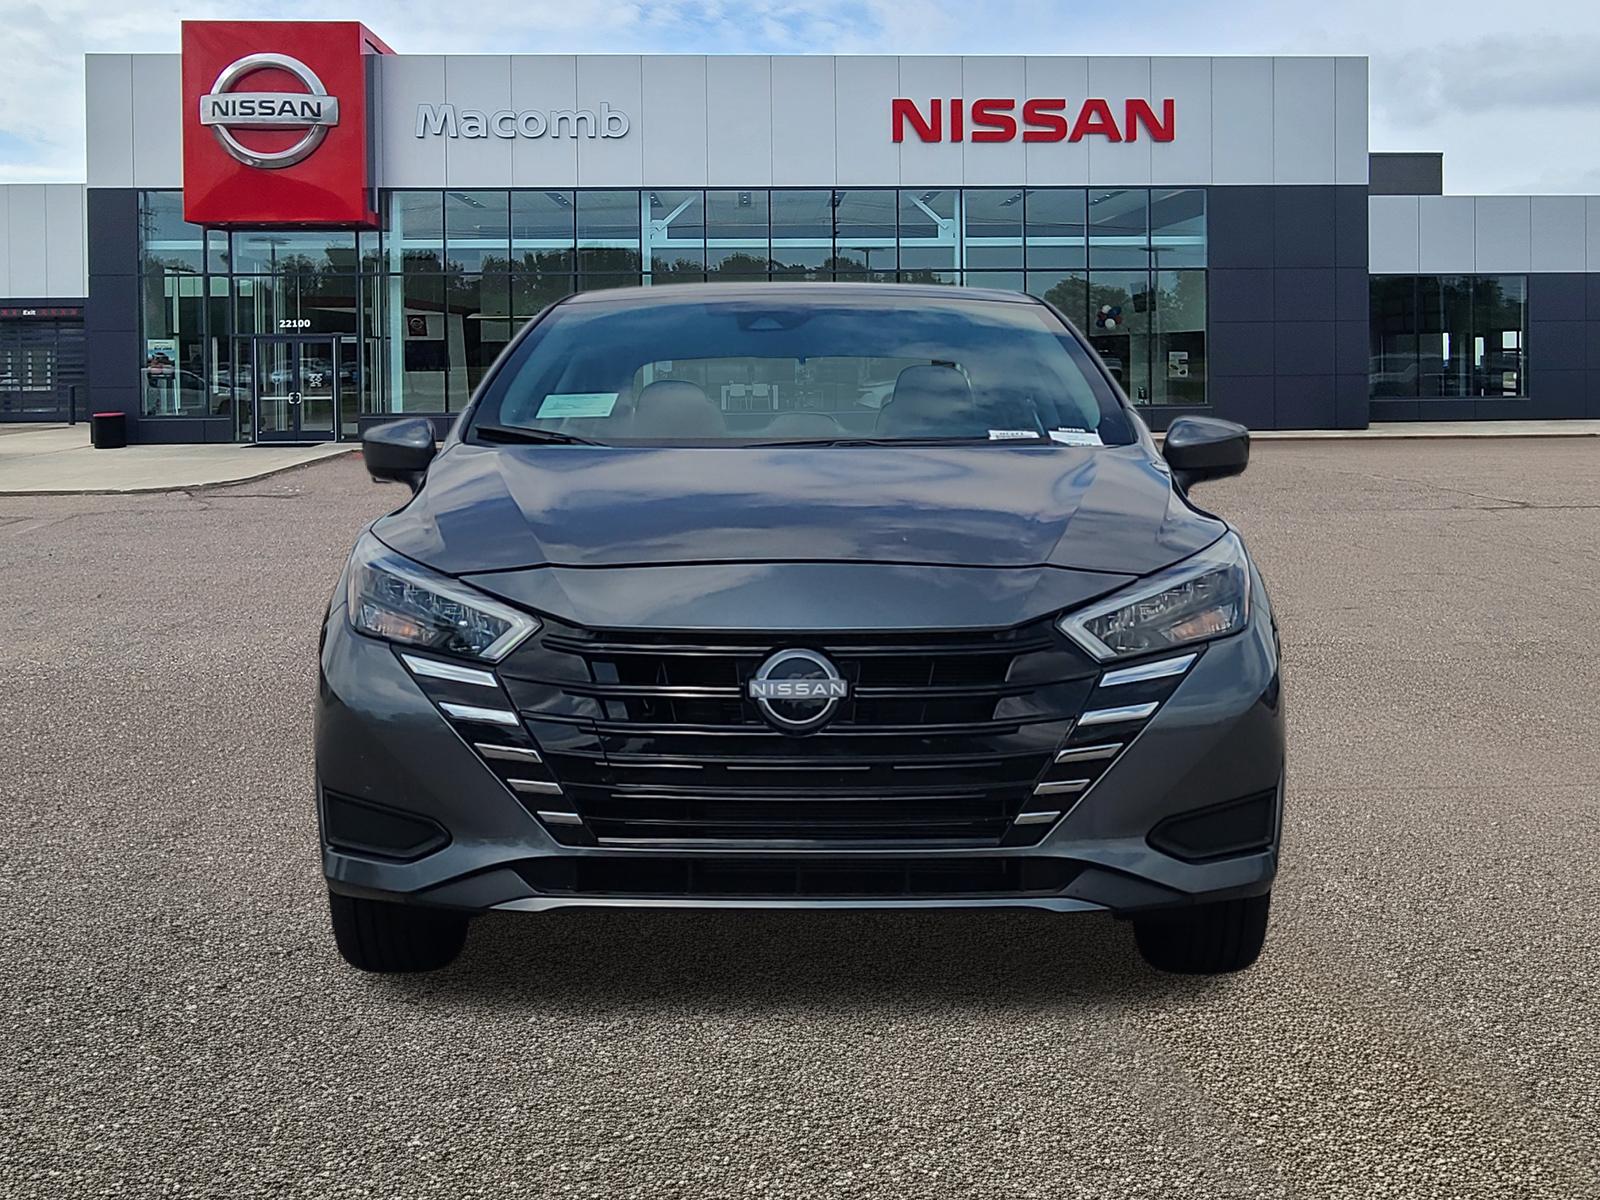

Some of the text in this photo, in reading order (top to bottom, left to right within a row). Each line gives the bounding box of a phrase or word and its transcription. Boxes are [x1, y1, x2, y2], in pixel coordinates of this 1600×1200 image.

[211, 99, 323, 118] NISSAN
[415, 101, 630, 139] Macomb
[892, 98, 1175, 143] NISSAN
[279, 319, 311, 328] 22100
[751, 683, 846, 696] NISSAN
